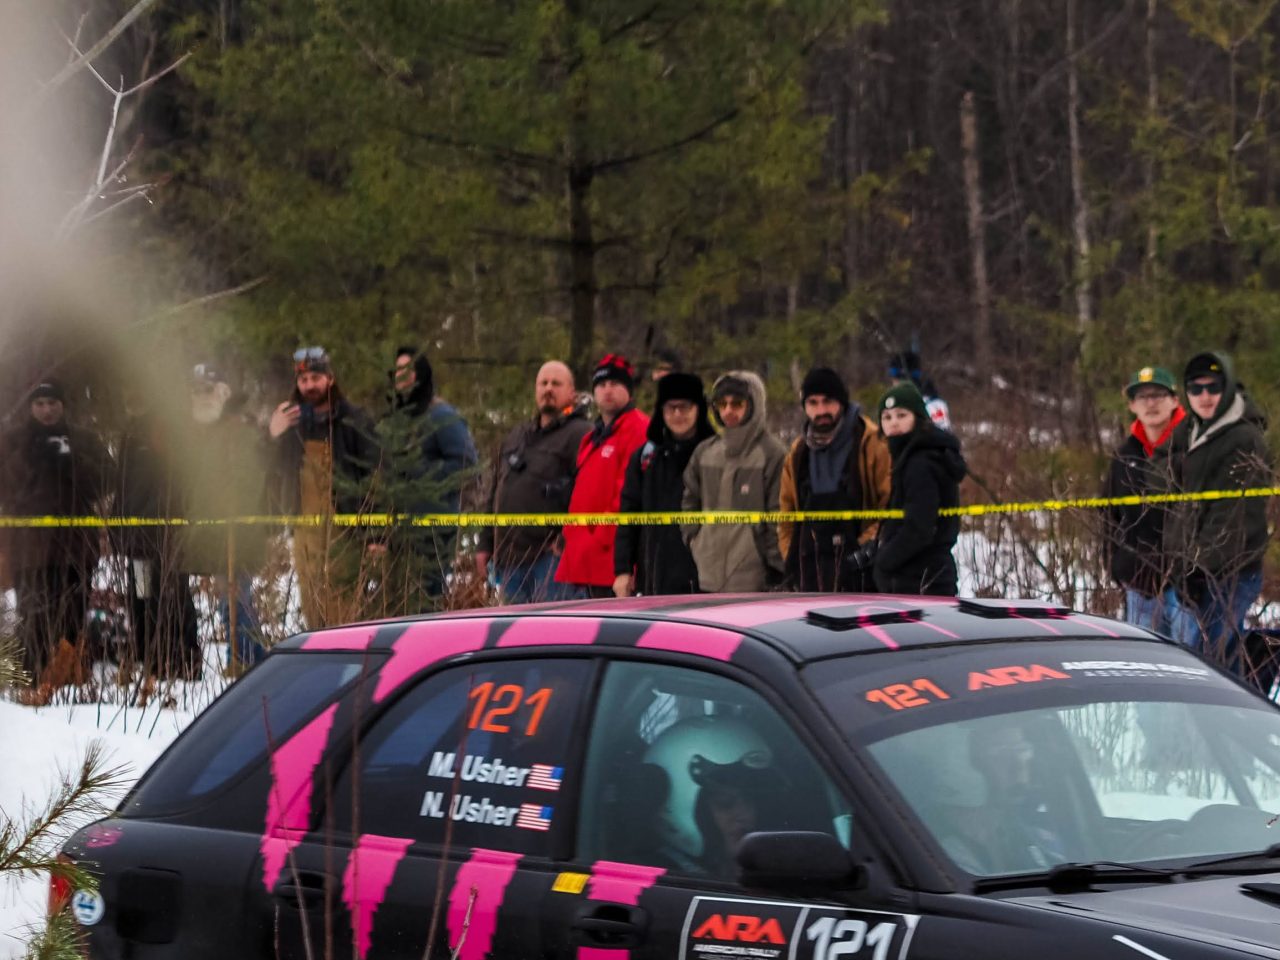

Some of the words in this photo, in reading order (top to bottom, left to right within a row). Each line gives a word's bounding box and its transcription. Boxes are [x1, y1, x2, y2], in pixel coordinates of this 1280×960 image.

[865, 678, 950, 710] 121
[968, 664, 1072, 691] ARA
[468, 682, 553, 736] 121
[427, 751, 456, 779] M.
[460, 754, 532, 787] Usher
[419, 790, 445, 818] N.
[450, 793, 520, 827] Usher
[691, 913, 787, 944] ARA
